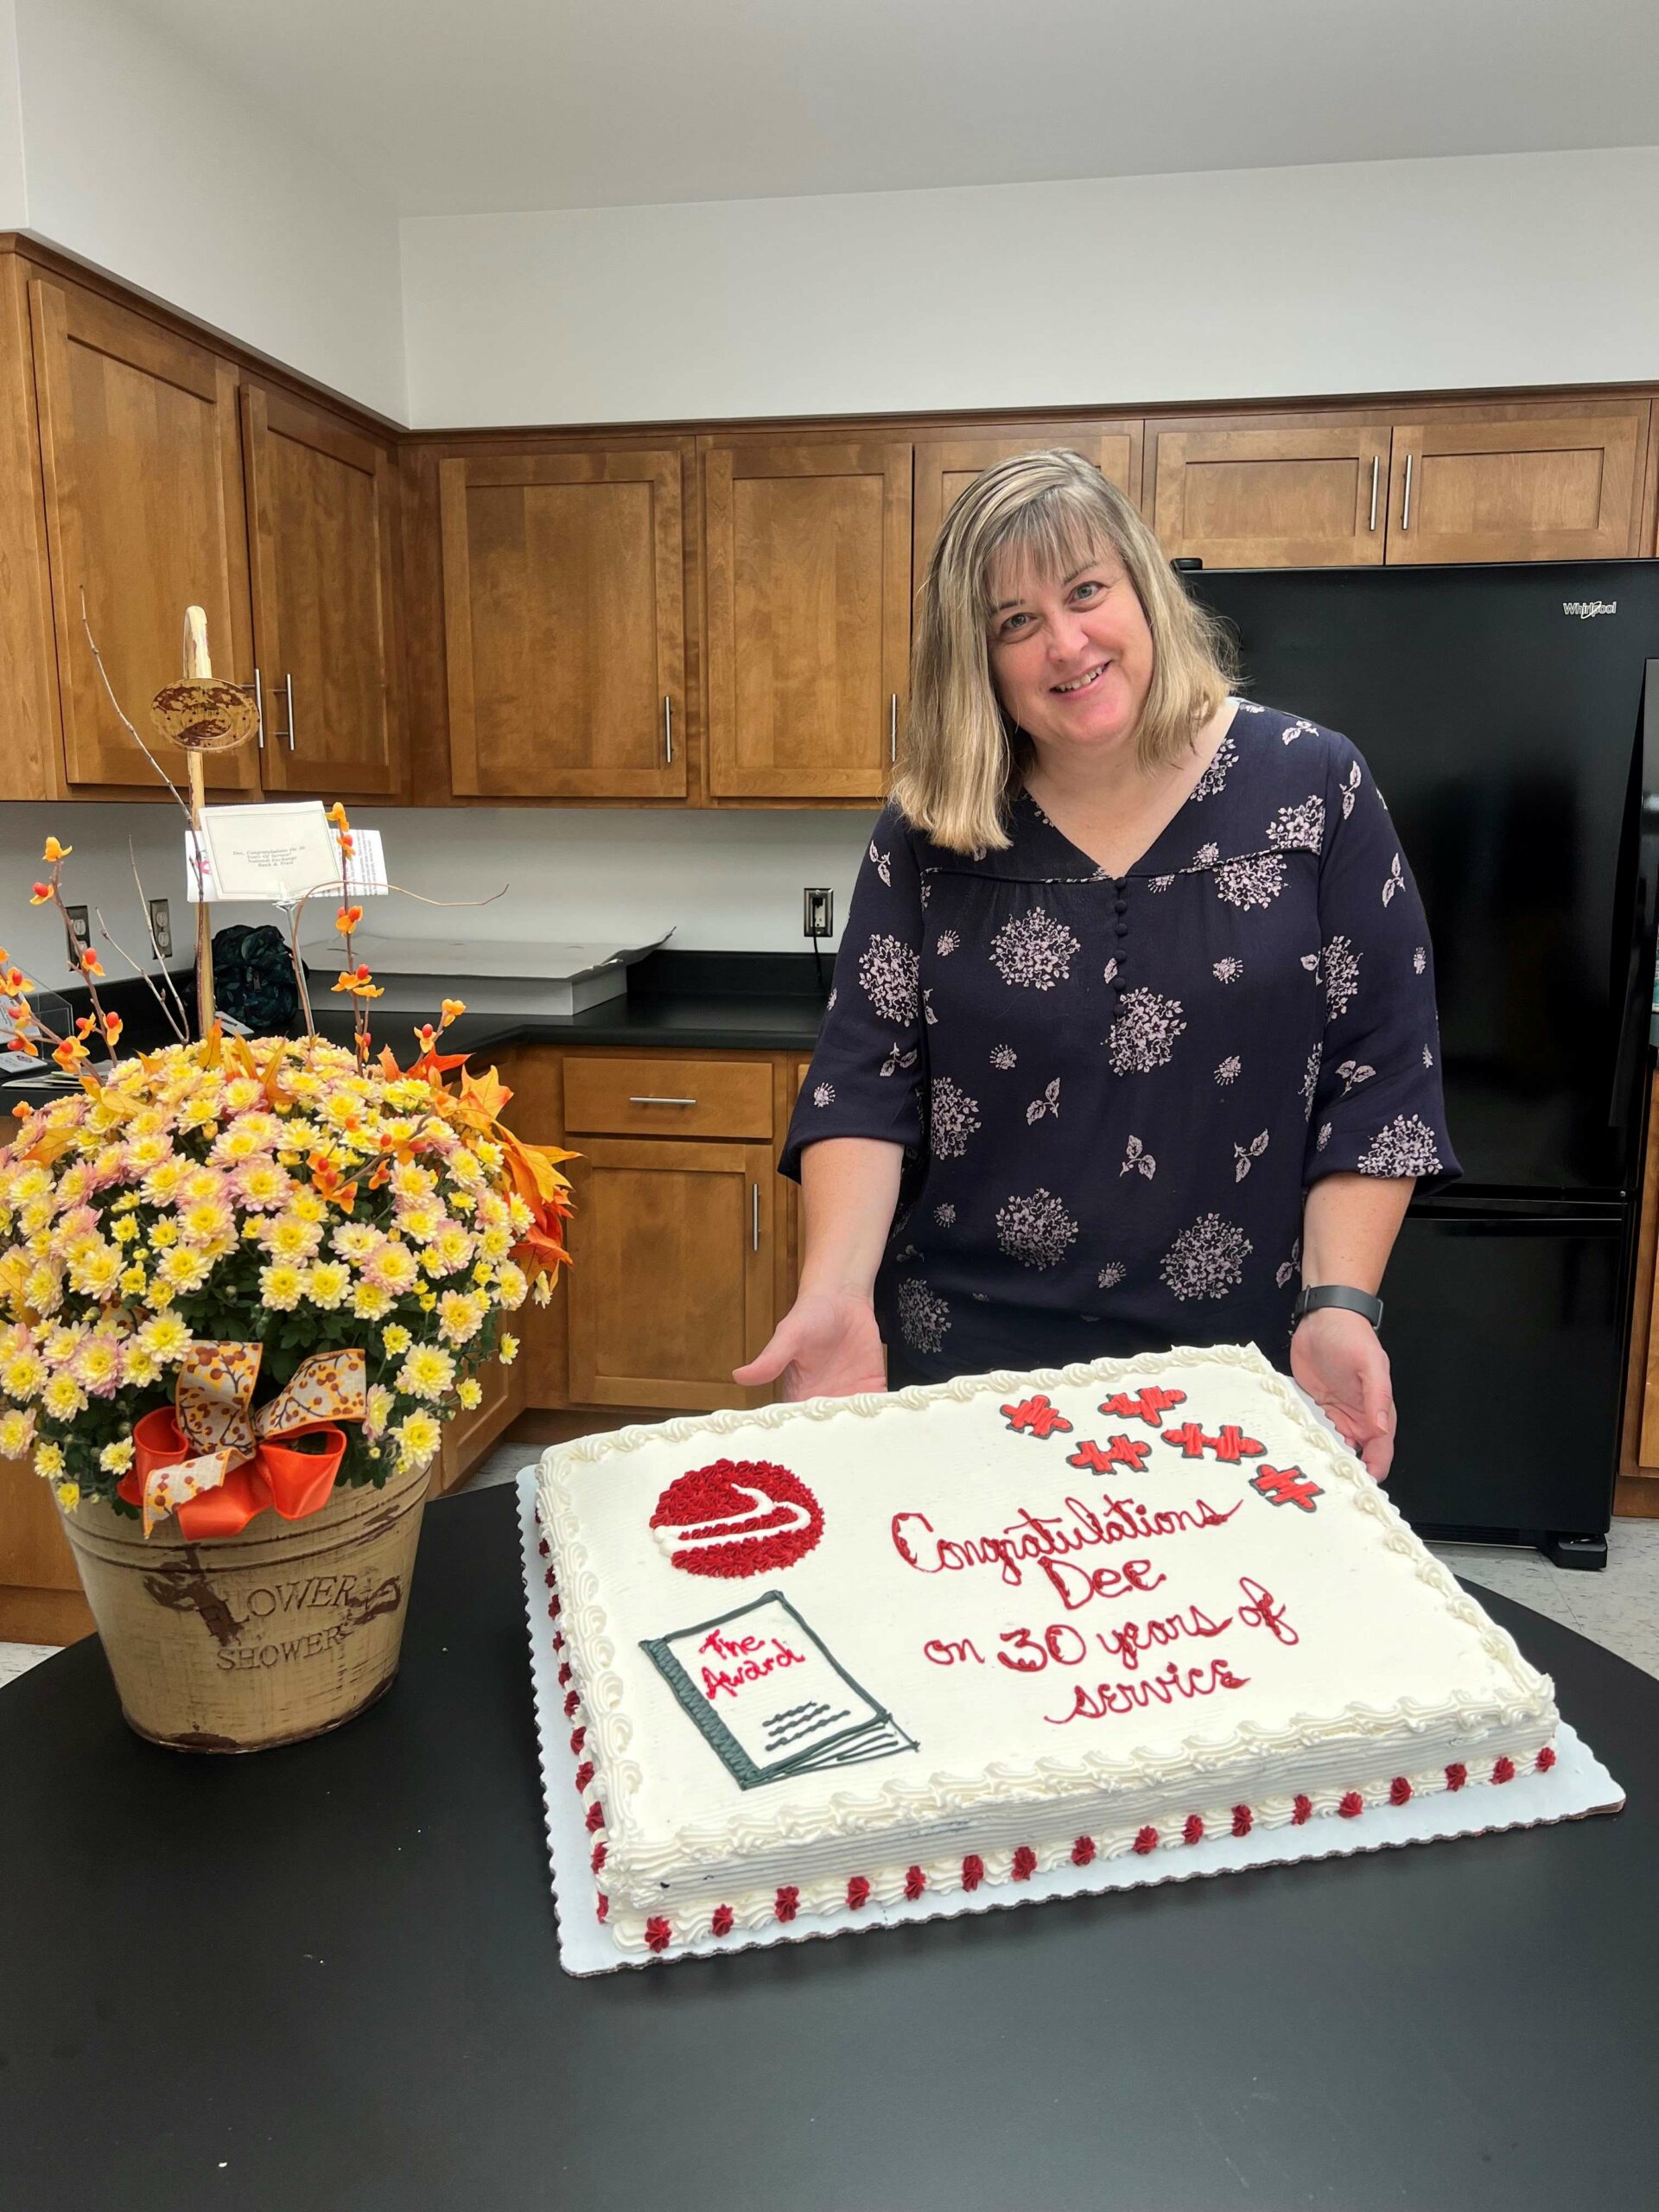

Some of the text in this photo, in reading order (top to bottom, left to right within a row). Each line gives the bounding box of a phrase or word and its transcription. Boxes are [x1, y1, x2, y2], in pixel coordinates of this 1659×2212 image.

[1563, 601, 1617, 619] Whirlpool
[892, 1495, 1244, 1586] Congratulations
[1037, 1559, 1167, 1610] Dee
[217, 1624, 352, 1671] SHOWER
[698, 1629, 766, 1660] The
[924, 1577, 1300, 1673] on 30 years of
[701, 1638, 806, 1700] Award
[1044, 1659, 1251, 1725] service
